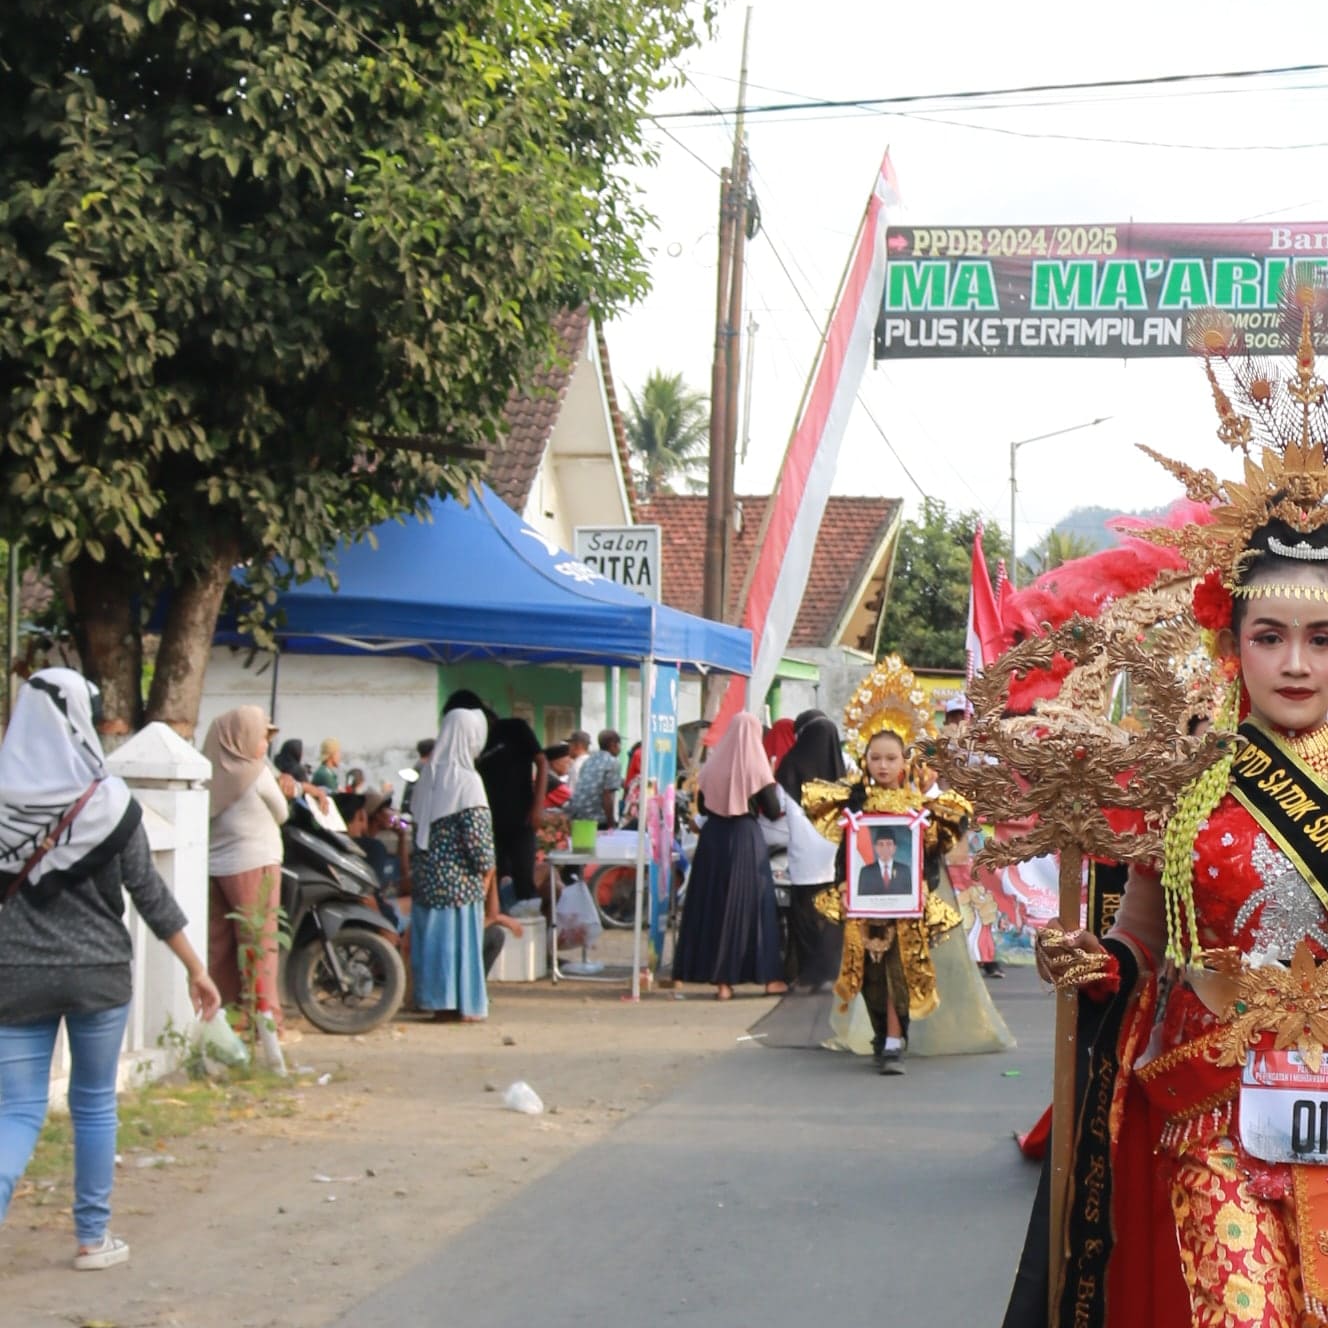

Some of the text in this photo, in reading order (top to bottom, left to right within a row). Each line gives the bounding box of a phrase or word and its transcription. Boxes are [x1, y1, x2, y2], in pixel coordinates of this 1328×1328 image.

[911, 226, 1118, 257] PPDB 2024/2025
[885, 258, 999, 311] MA
[885, 318, 957, 347] PLUS
[962, 317, 1184, 347] KETERAMPILAN
[587, 532, 649, 553] Salon
[1257, 768, 1321, 823] SATDIK
[1085, 1155, 1105, 1224] Rias
